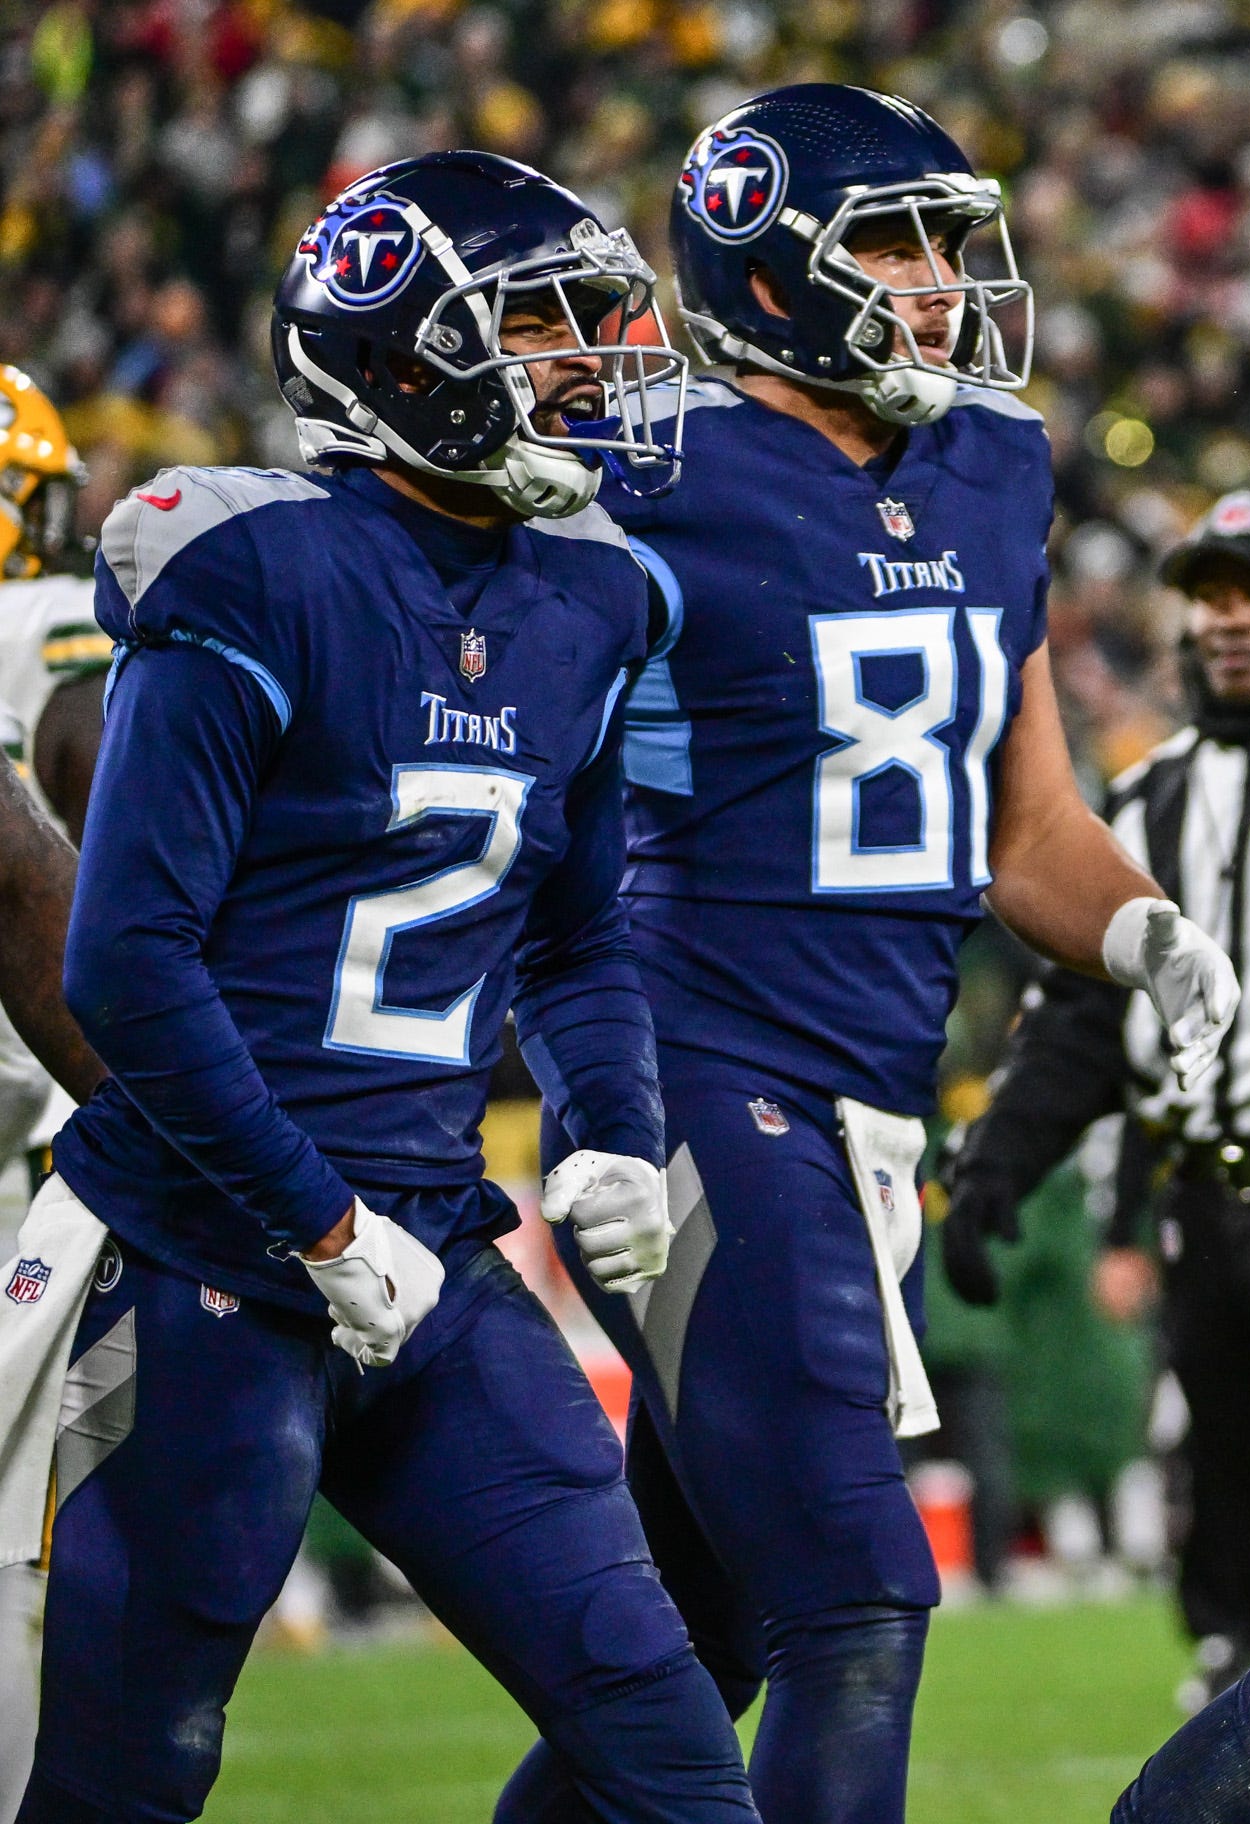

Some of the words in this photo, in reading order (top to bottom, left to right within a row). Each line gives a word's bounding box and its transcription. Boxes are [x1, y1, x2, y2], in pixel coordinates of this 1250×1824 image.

[857, 550, 965, 598] TITANS
[463, 653, 482, 672] NFL
[420, 690, 517, 756] TITANS
[808, 606, 1009, 894] 81
[321, 763, 537, 1067] 2
[9, 1274, 41, 1301] NFL
